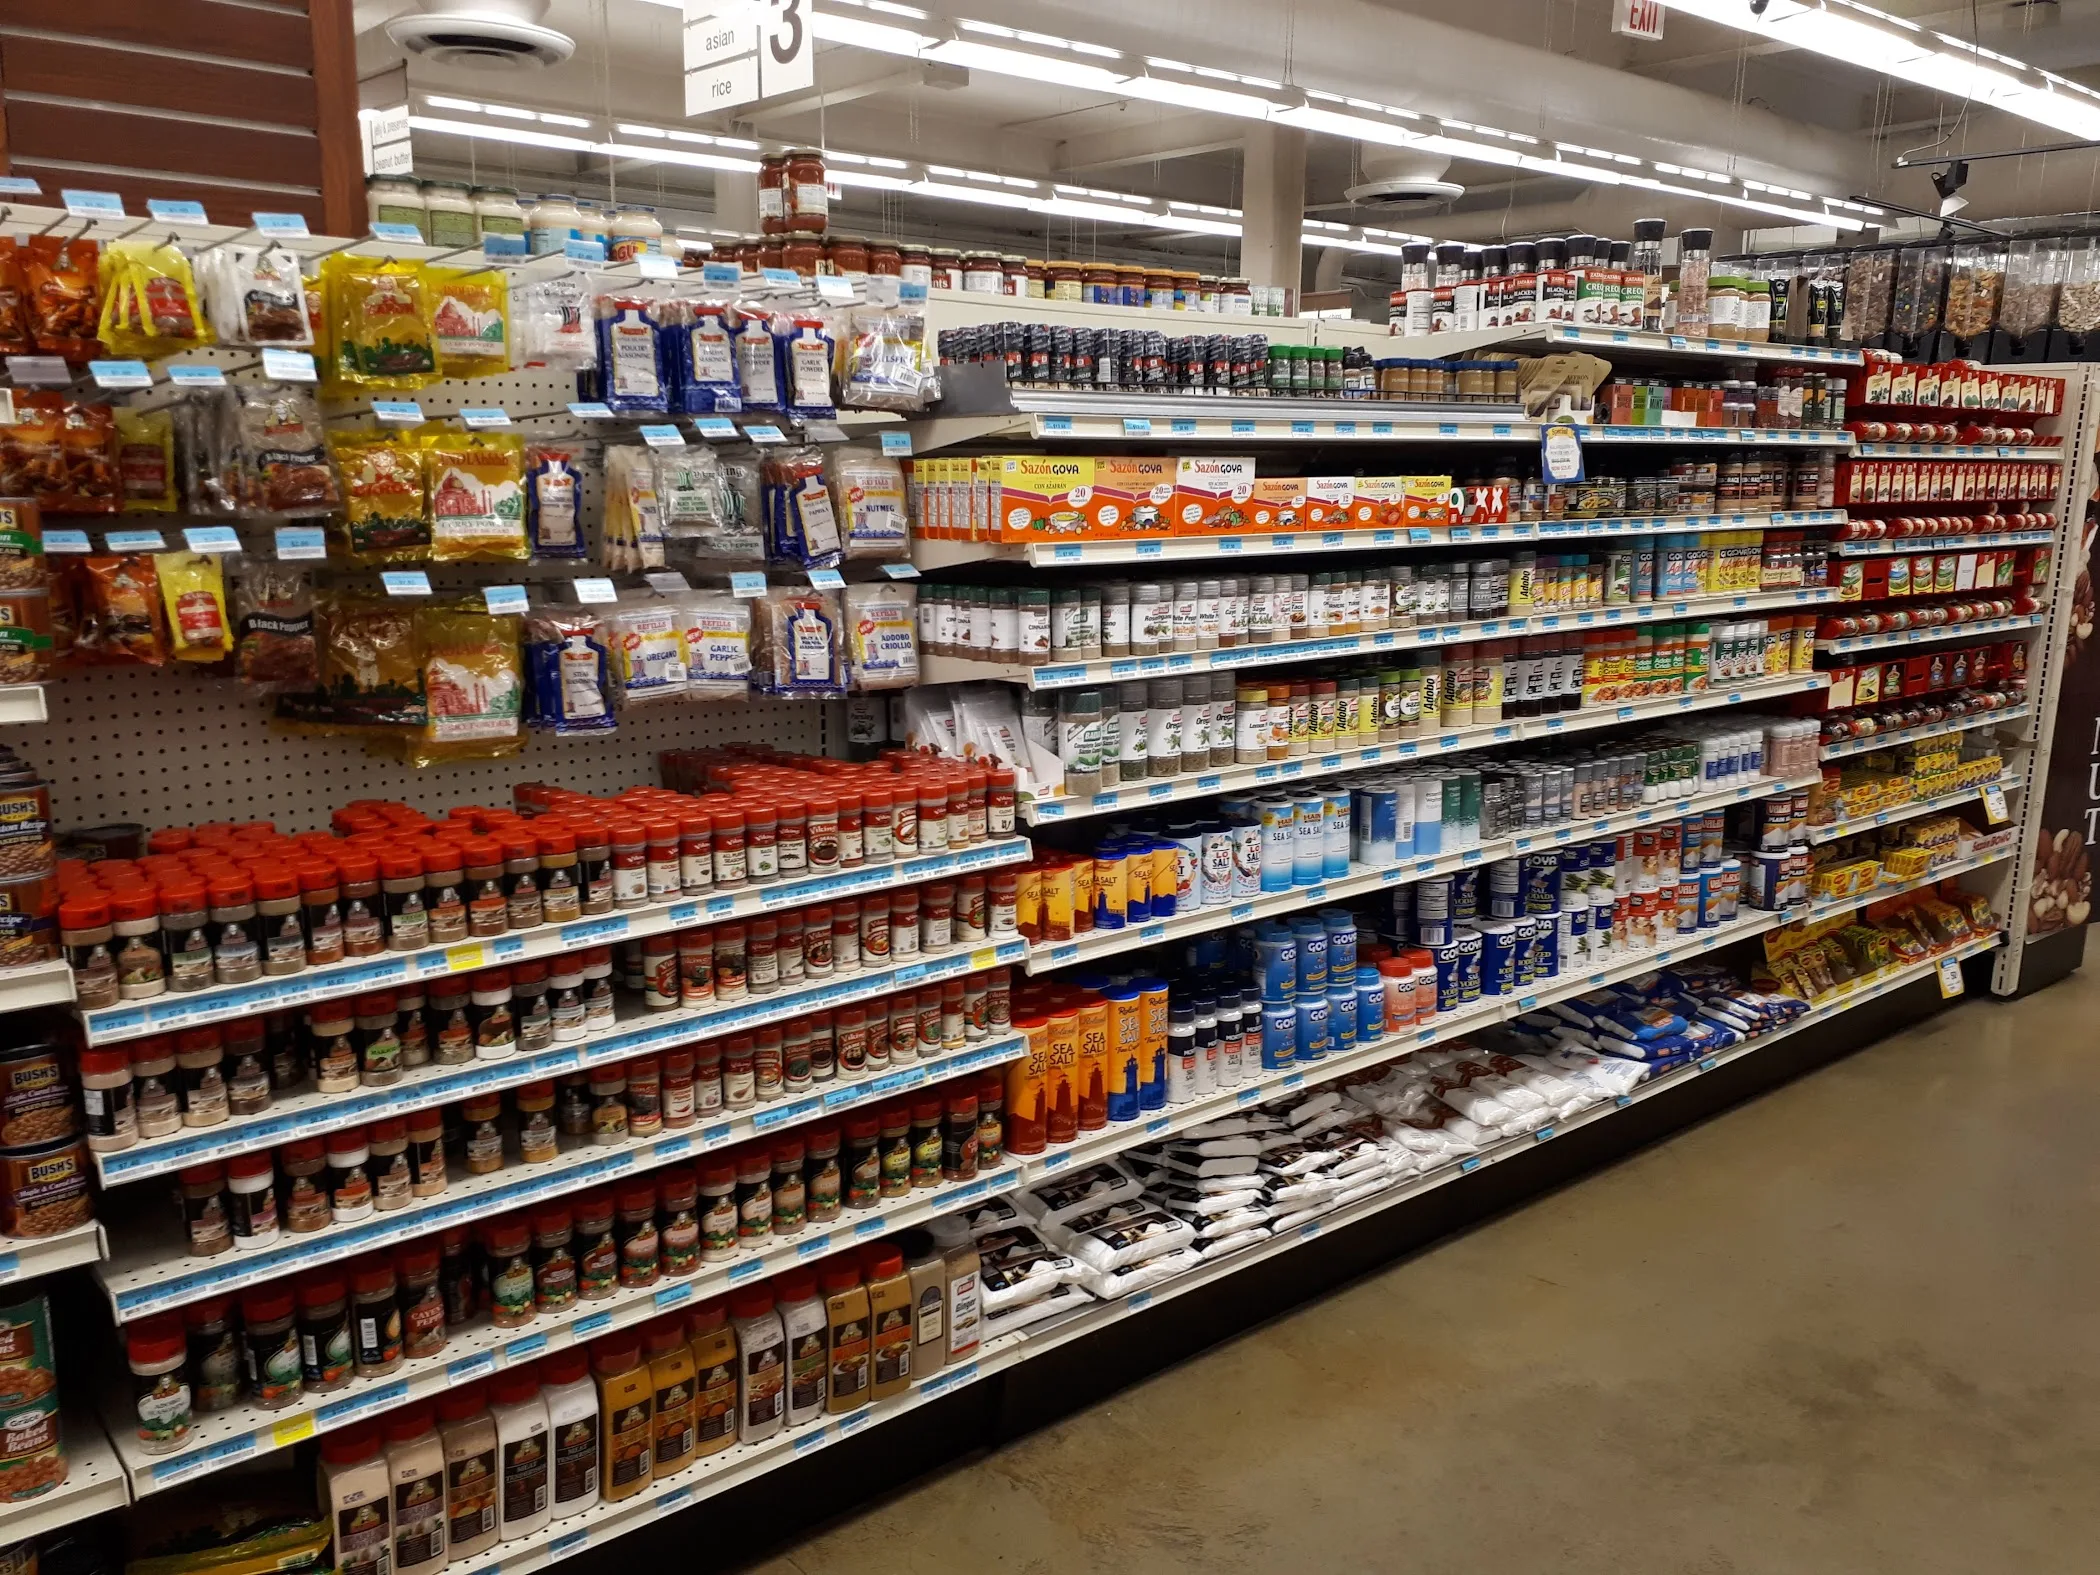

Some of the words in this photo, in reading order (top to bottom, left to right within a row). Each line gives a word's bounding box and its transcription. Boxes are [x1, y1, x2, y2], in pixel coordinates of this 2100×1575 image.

[769, 0, 803, 64] 3
[706, 29, 735, 51] asian
[712, 79, 732, 98] rice
[1020, 460, 1050, 475] Sazón
[1052, 465, 1079, 474] GOYA
[1110, 459, 1138, 474] Sazón
[1138, 465, 1163, 474] GOYA
[1195, 459, 1220, 473] Sazón
[1220, 465, 1243, 473] GOYA
[1155, 486, 1165, 496] 20
[1237, 485, 1247, 495] 20
[1281, 483, 1299, 491] GOYA
[1333, 482, 1348, 490] GOYA
[1382, 481, 1396, 489] GOYA
[1075, 488, 1087, 498] 20
[866, 505, 895, 513] NUTMEG
[1522, 570, 1531, 598] Adobo
[870, 610, 898, 619] REFILLS
[637, 621, 667, 631] REFILLS
[701, 618, 733, 628] REFILLS
[710, 644, 739, 654] GARLIC
[646, 650, 678, 662] OREGANO
[1446, 670, 1456, 700] Adobo
[1425, 678, 1434, 711] Adobo
[1338, 701, 1347, 730] Adobo
[20, 820, 48, 830] Recipe
[809, 823, 838, 834] Viking
[1299, 827, 1311, 835] SEA
[1333, 821, 1344, 830] SEA
[1213, 858, 1230, 867] SALT
[1101, 877, 1117, 885] SALT
[1085, 1032, 1106, 1045] SEA
[1052, 1043, 1074, 1055] SEA
[1083, 1042, 1106, 1055] SALT
[1050, 1052, 1075, 1065] SALT
[14, 1065, 58, 1086] BUSH'S
[30, 1157, 74, 1180] BUSH'S
[6, 1420, 48, 1443] Baked
[8, 1433, 49, 1452] Beans
